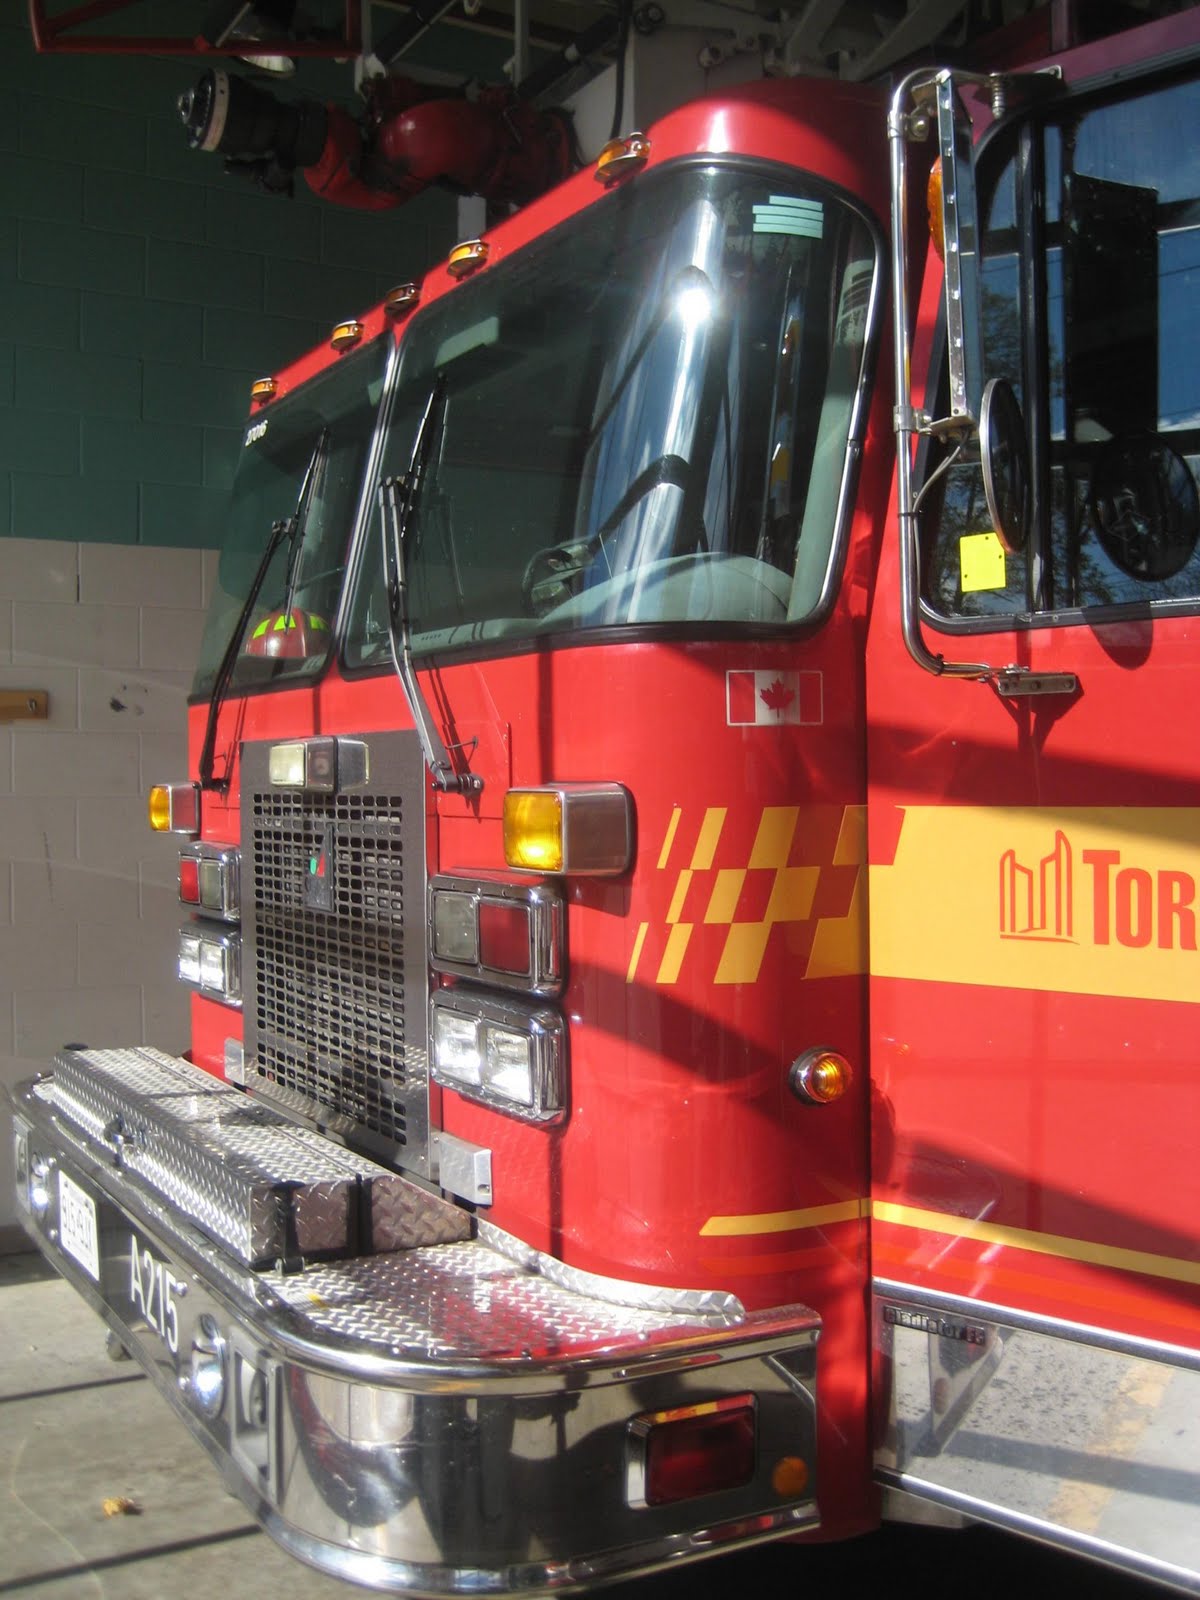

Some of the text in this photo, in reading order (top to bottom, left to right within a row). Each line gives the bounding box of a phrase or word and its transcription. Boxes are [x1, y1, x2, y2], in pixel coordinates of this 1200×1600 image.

[1082, 849, 1198, 951] TOR
[130, 1234, 178, 1353] A215
[884, 1305, 962, 1340] Gladiator
